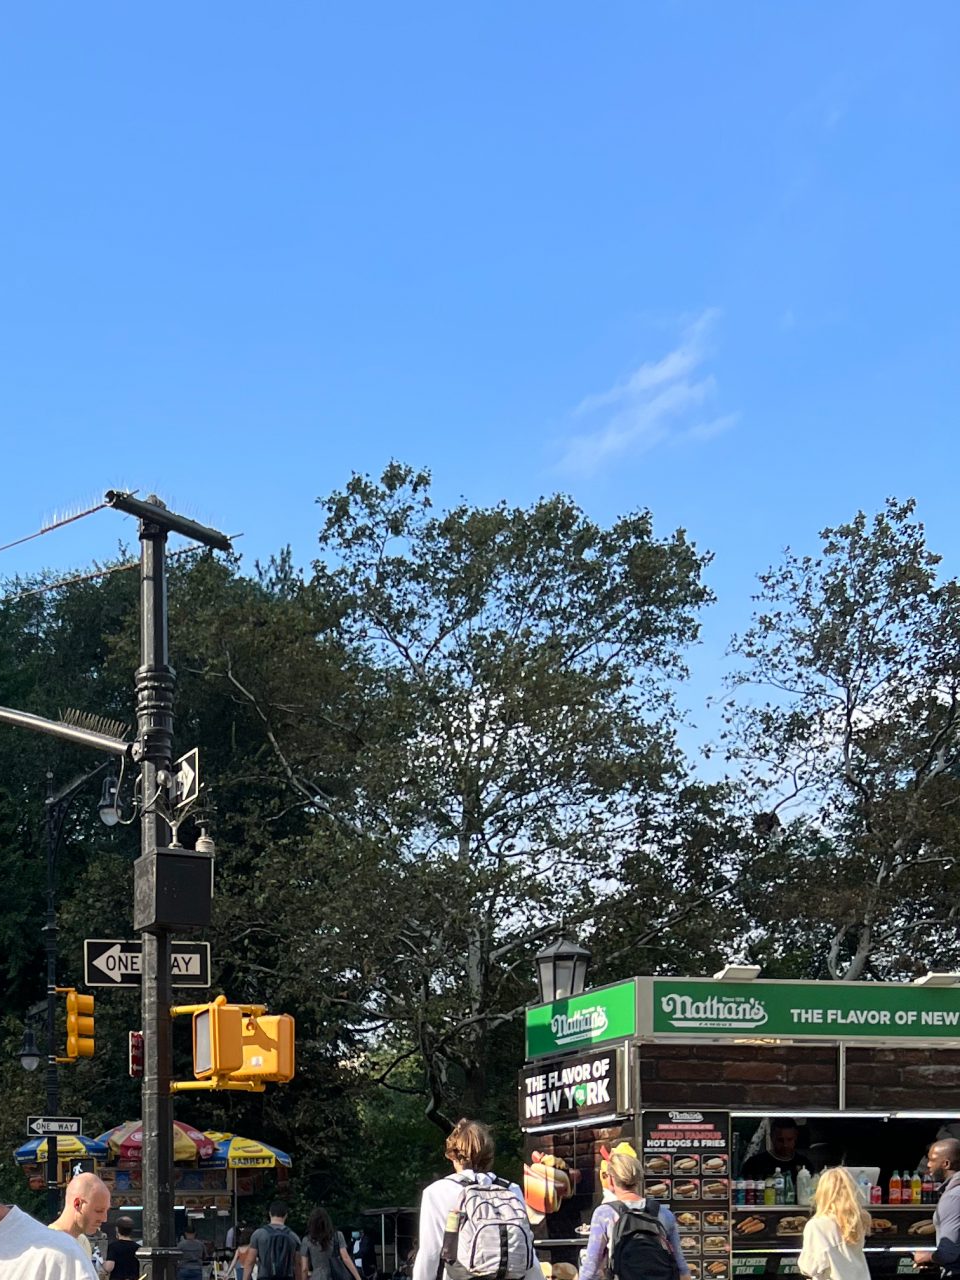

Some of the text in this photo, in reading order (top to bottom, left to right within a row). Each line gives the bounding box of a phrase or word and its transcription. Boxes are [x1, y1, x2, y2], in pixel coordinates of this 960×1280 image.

[106, 955, 193, 972] ONE AY
[661, 994, 766, 1020] Nathan's
[790, 1009, 959, 1025] THE FLAVOR OF NEW
[551, 1006, 608, 1038] Nathan's
[525, 1058, 610, 1093] THE FLAVOR OF
[525, 1078, 610, 1119] NEW YRK
[36, 1122, 74, 1131] ONE WAY
